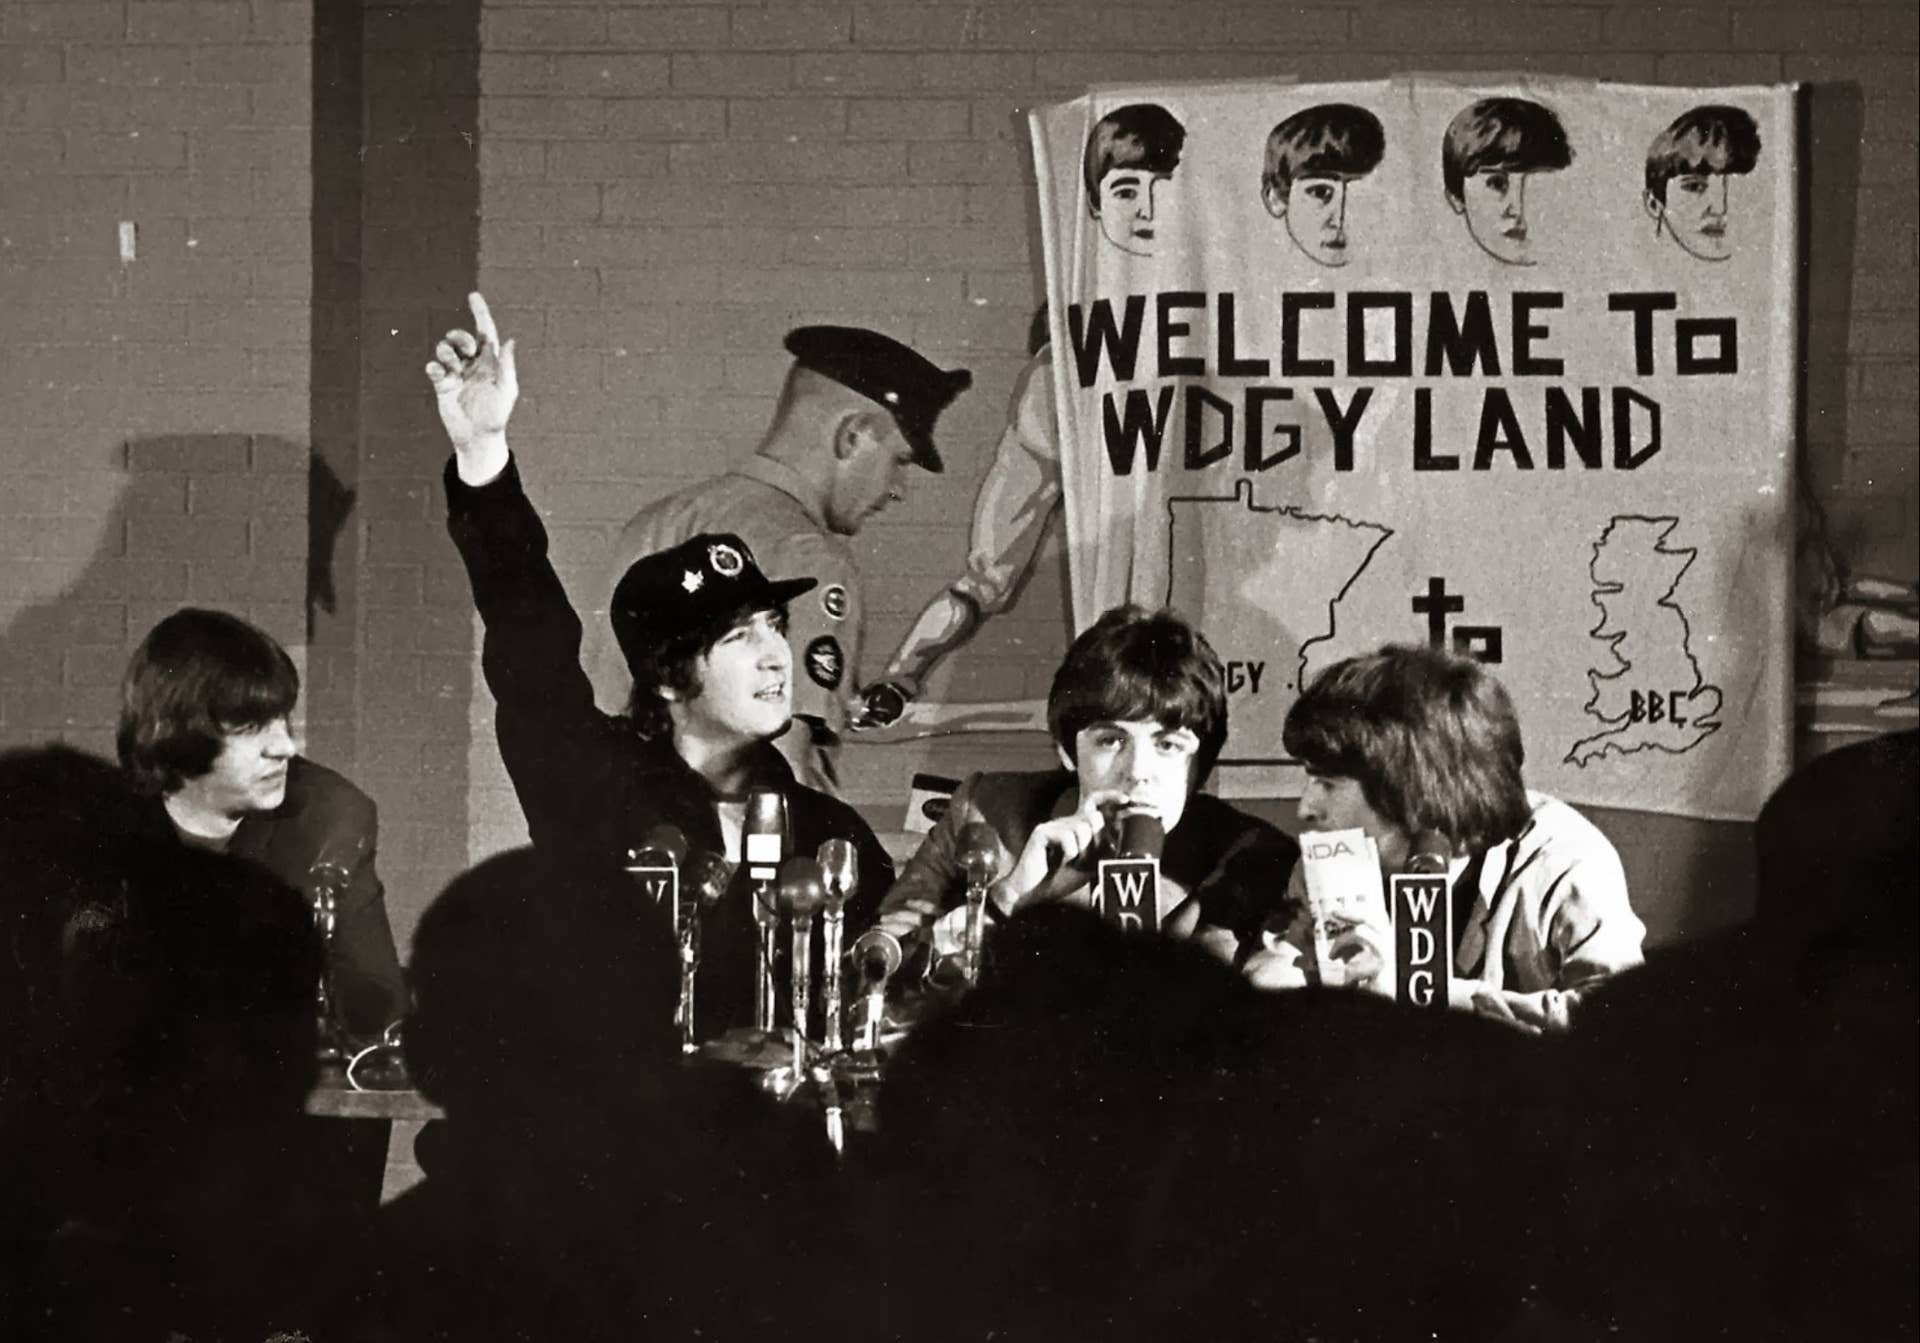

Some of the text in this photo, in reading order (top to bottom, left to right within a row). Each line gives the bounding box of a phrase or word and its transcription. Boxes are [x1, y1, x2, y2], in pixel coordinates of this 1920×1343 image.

[1067, 291, 1564, 389] WELCOME
[1102, 385, 1661, 476] WDGY LAND
[1226, 661, 1265, 693] GY
[1630, 689, 1687, 724] BBC
